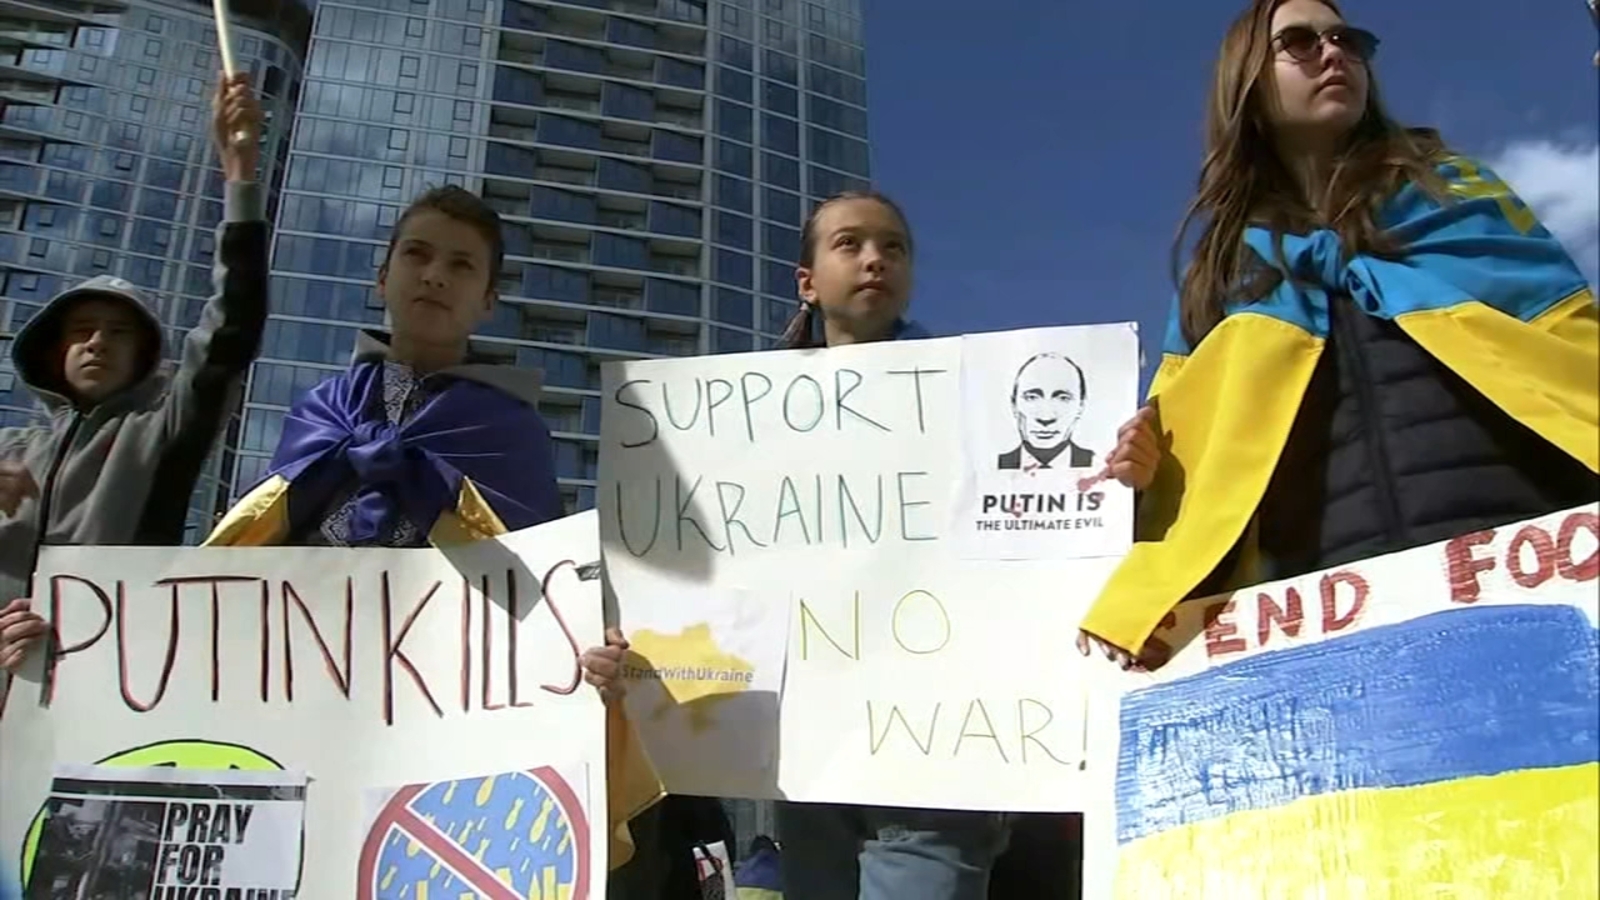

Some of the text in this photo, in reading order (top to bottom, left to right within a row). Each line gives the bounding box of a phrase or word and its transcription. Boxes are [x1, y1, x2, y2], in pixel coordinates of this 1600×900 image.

[614, 367, 948, 449] SUPPORT
[616, 471, 939, 559] UKRAINE
[976, 517, 1104, 531] THE ULTIMATE EVIL
[982, 492, 1106, 515] PUTIN IS
[39, 560, 583, 726] PUTIN KILLS
[799, 589, 951, 661] NO
[617, 664, 755, 683] StandWithUkraine
[866, 697, 1089, 770] WAR!
[163, 801, 254, 844] PRAY
[156, 843, 225, 886] FOR
